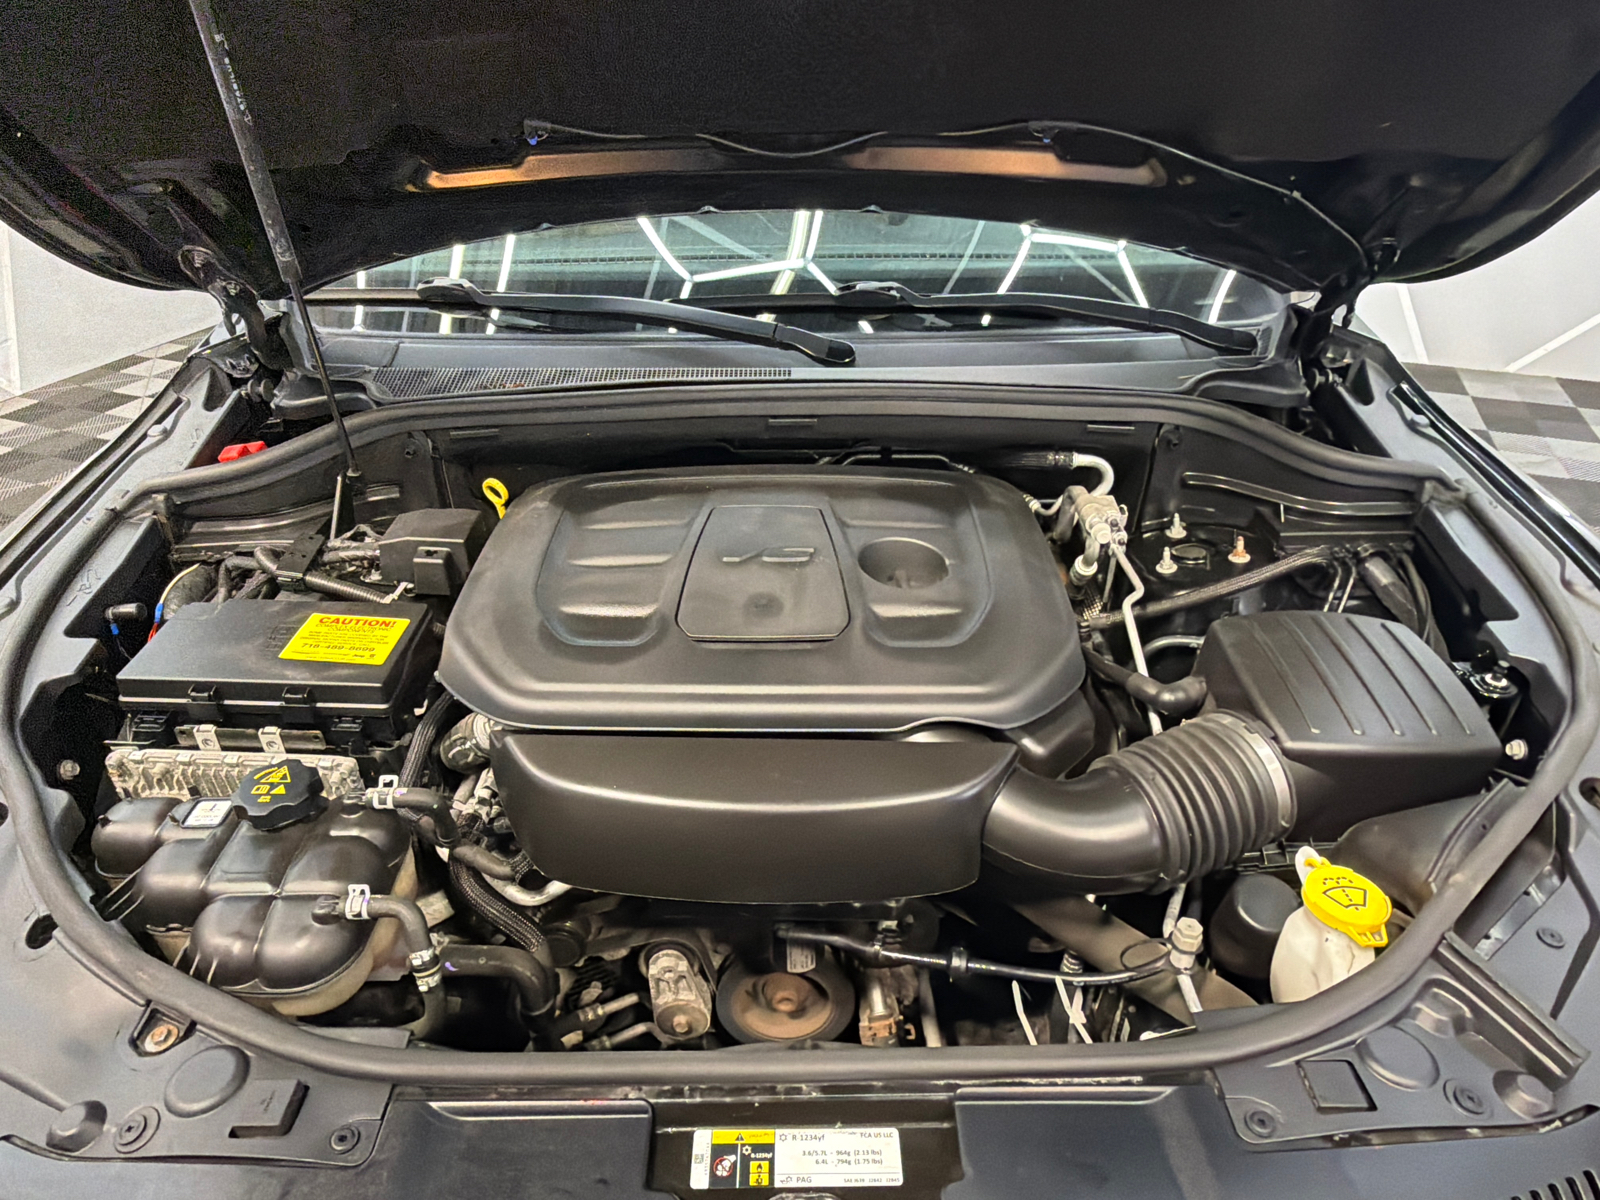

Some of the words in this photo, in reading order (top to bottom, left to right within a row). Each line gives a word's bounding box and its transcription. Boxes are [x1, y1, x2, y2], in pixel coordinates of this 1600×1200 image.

[319, 617, 397, 628] CAUTION!
[791, 1133, 825, 1142] R-1234yf
[836, 1149, 851, 1157] 964g
[870, 1149, 882, 1157] lbs)
[836, 1158, 851, 1166] 794g
[871, 1158, 883, 1166] lbs)
